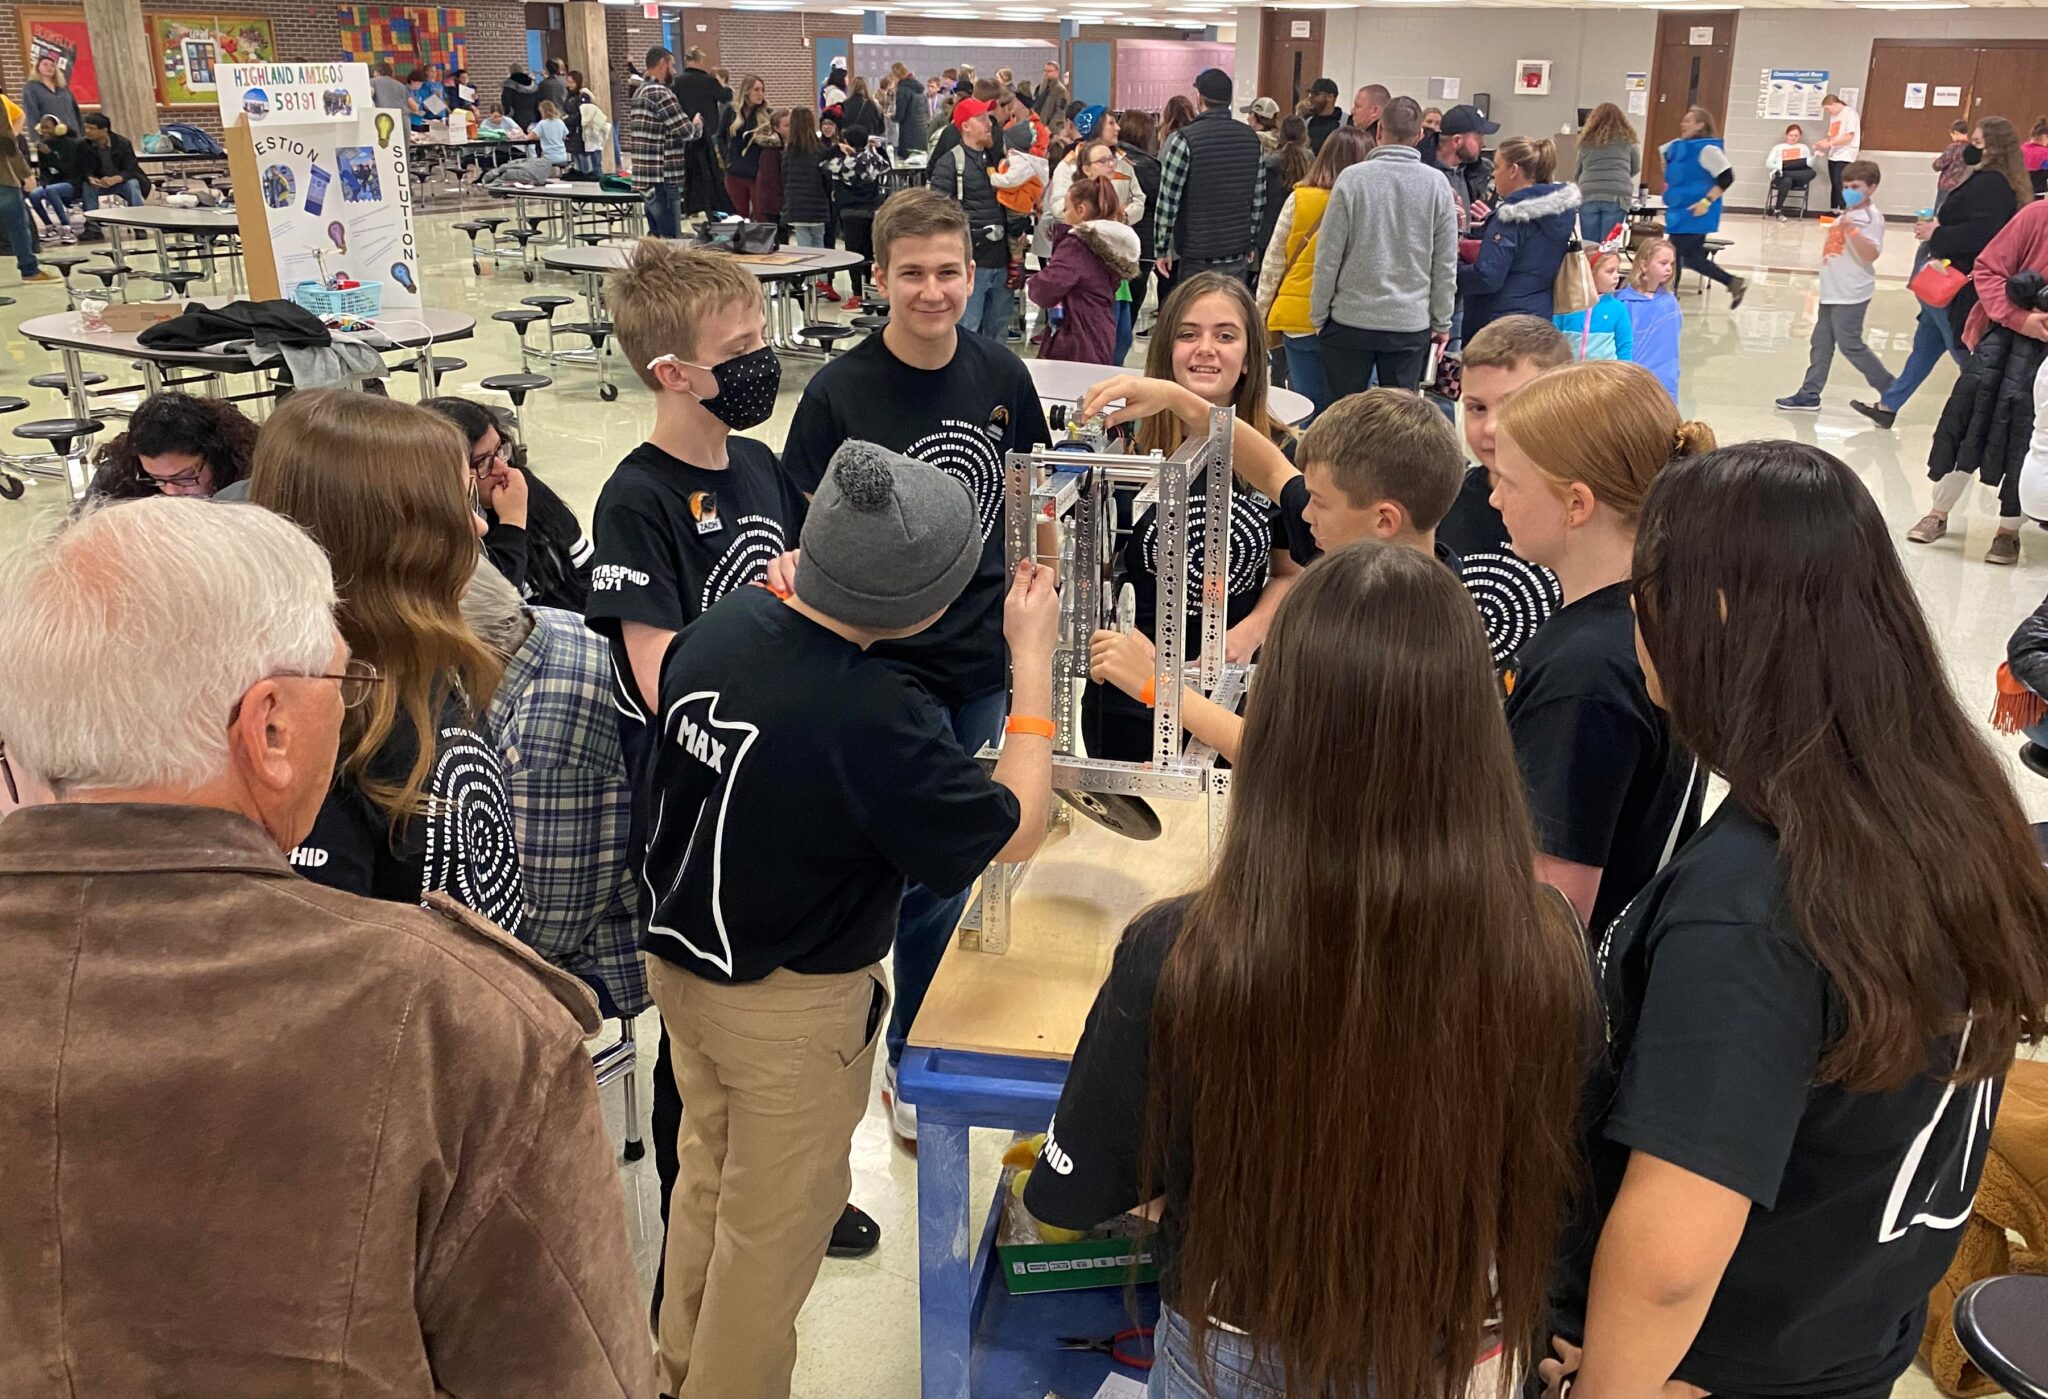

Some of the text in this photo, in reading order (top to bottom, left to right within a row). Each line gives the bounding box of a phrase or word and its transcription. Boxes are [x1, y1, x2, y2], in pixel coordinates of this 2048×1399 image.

[234, 64, 344, 87] HIGHLAND AMIGOS
[275, 91, 316, 111] 58191
[393, 146, 413, 260] SOLUTION
[956, 420, 973, 429] LEGO
[915, 432, 947, 448] ACTUALLY
[700, 521, 718, 531] ZACH
[737, 516, 749, 525] THE
[706, 565, 720, 586] THAT
[719, 556, 727, 565] IS
[593, 578, 621, 591] 9671
[1482, 592, 1510, 621] ACTUALLY
[677, 715, 726, 774] MAX
[425, 828, 435, 861] TEAM
